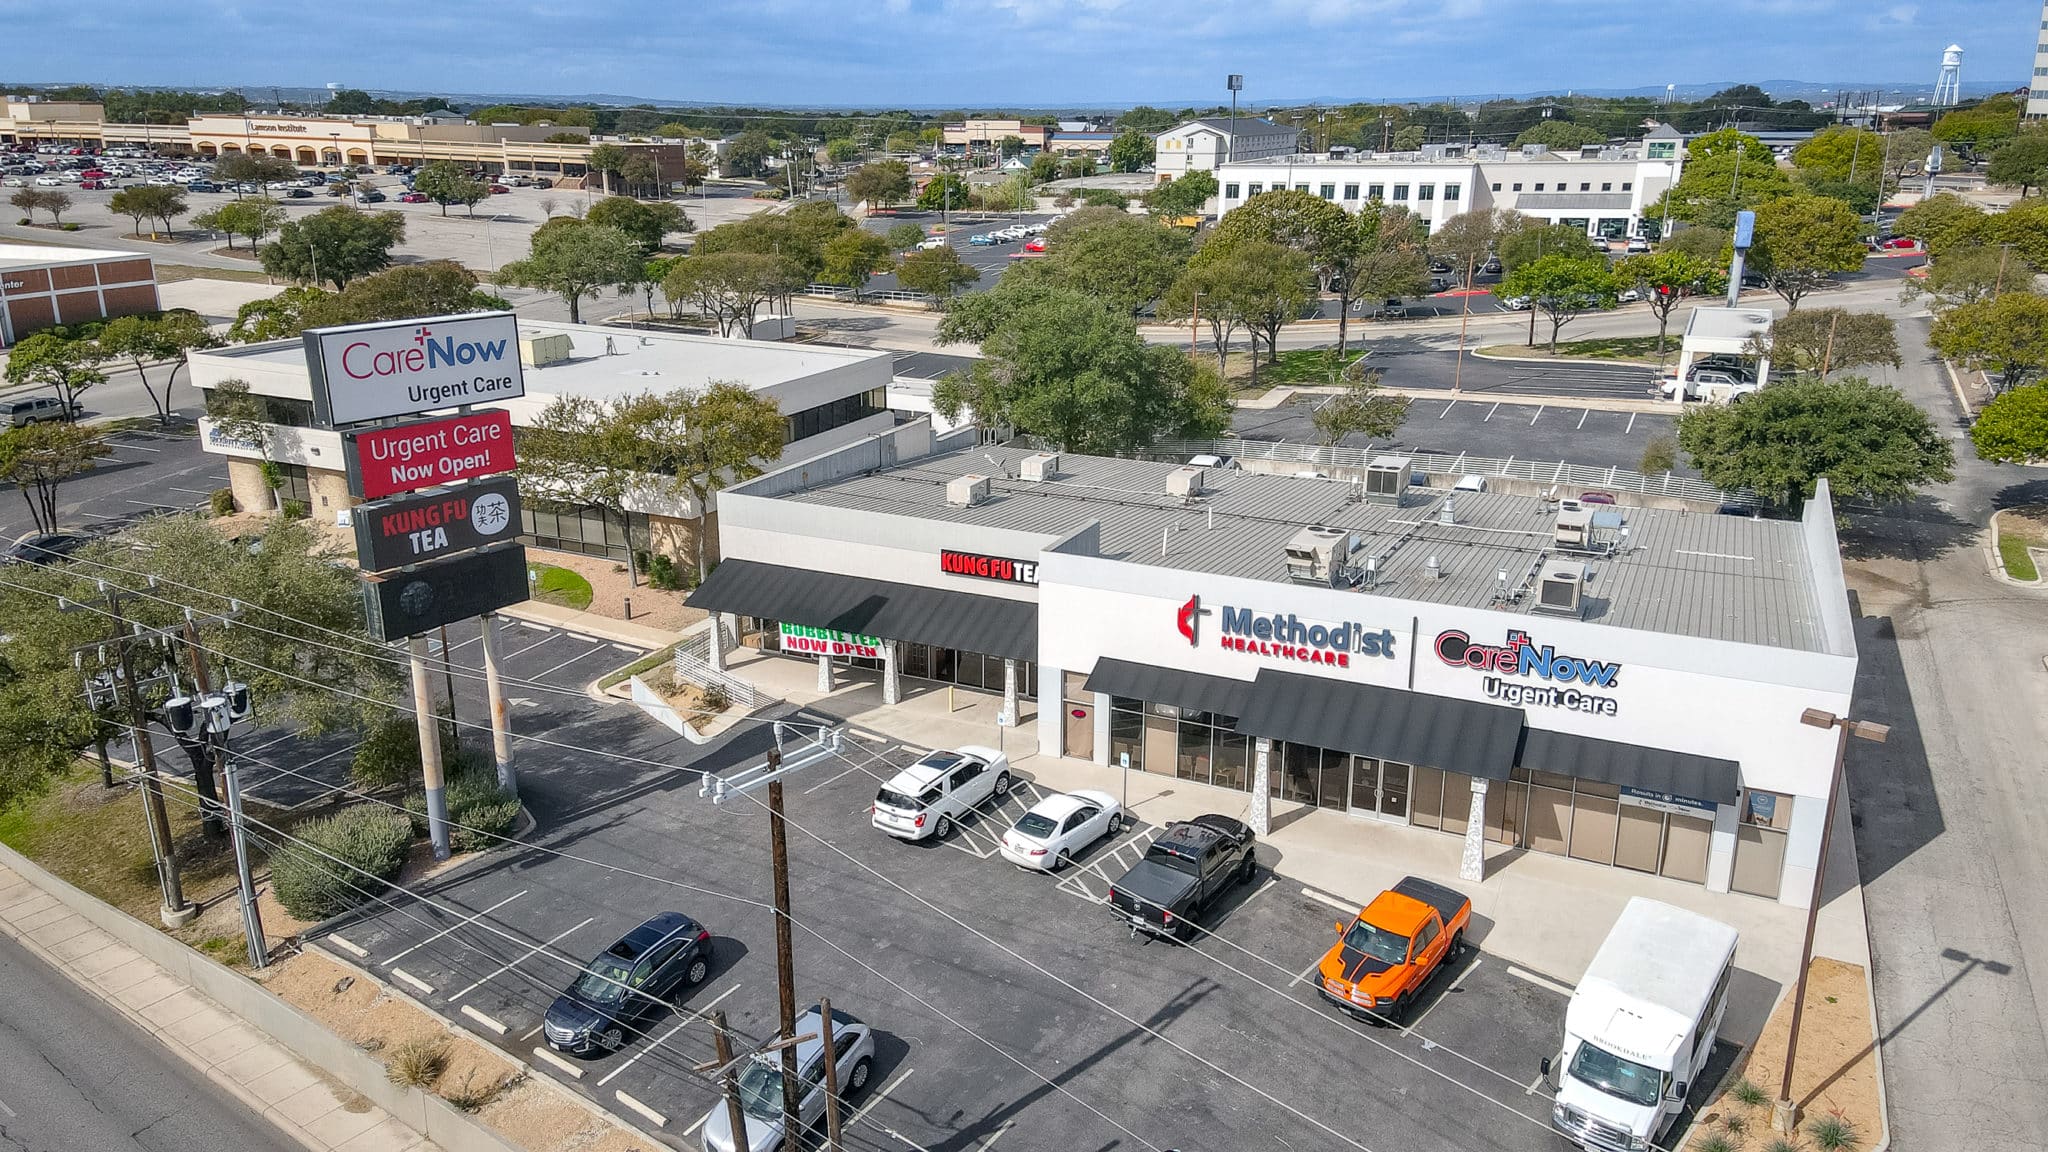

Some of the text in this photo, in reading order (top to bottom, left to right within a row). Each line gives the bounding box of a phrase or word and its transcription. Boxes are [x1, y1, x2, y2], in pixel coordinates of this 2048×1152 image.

[342, 336, 507, 379] CareNow
[408, 376, 512, 404] Urgent Care
[371, 423, 501, 461] Urgent Care
[391, 449, 491, 484] Now Open!
[382, 499, 468, 537] KUNG FU
[409, 526, 449, 555] TEA
[941, 552, 988, 576] KUNG
[991, 558, 1012, 579] FU
[781, 622, 845, 642] BUBBLE
[787, 636, 877, 657] NOW OPEN
[1221, 605, 1395, 659] Methodist
[1221, 636, 1350, 668] HEALTHCARE
[1483, 676, 1618, 716] Urgent Care
